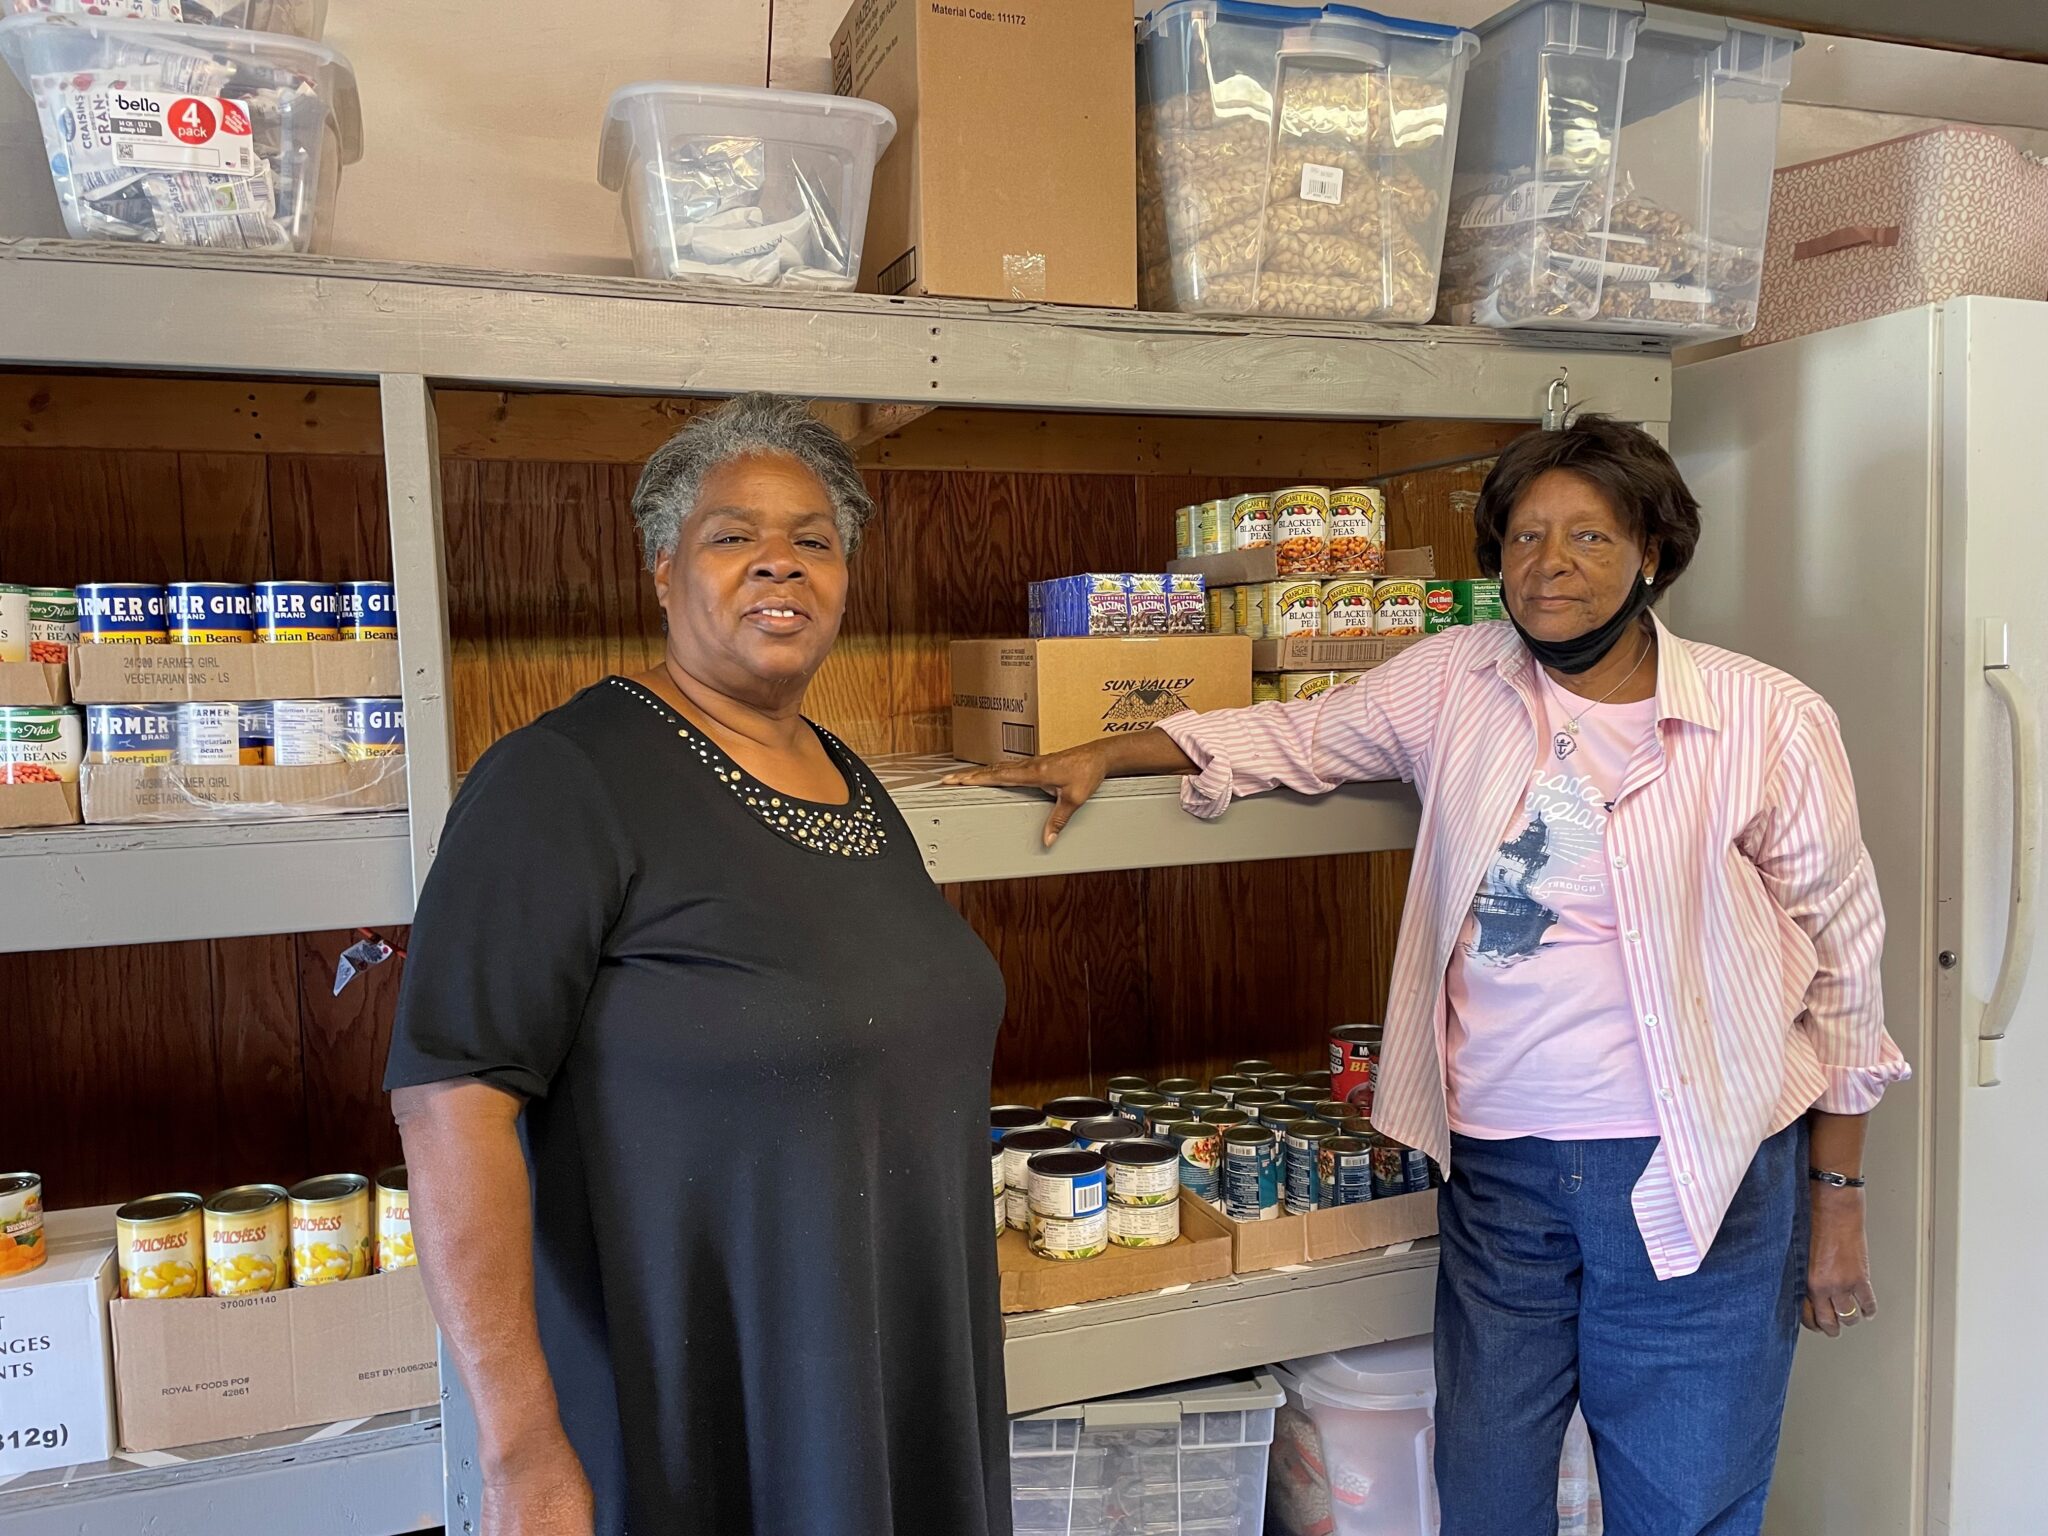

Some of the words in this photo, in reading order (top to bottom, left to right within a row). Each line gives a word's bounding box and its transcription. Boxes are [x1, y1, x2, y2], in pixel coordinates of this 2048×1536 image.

[931, 3, 967, 18] Material
[968, 8, 996, 22] Code:
[997, 12, 1027, 26] 111172
[115, 94, 160, 113] bella
[181, 102, 201, 128] 4
[74, 94, 93, 150] CRAISINS
[178, 125, 208, 139] pack
[1278, 518, 1321, 529] BLACKEYE
[1330, 519, 1366, 529] ACKEYE
[1288, 527, 1312, 536] PEAS
[1333, 528, 1355, 536] PEAS
[110, 615, 145, 623] BRAND
[176, 613, 206, 621] BRAND
[274, 611, 307, 619] BRAND
[1345, 618, 1366, 627] PEAS
[1391, 617, 1414, 626] PEAS
[206, 633, 243, 644] Beans
[363, 630, 399, 641] Beans
[156, 657, 195, 669] FARMER
[197, 656, 220, 668] GIRL
[124, 673, 186, 685] VEGETARIAN
[217, 672, 230, 683] LS
[1101, 680, 1136, 691] SUN
[1139, 678, 1195, 690] VALLEY
[978, 696, 1003, 711] SEEDLESS
[1002, 699, 1024, 713] RAISINS
[89, 716, 169, 735] FARMER
[141, 734, 170, 742] BRAND
[23, 743, 43, 751] Red
[23, 751, 68, 762] BEANS
[208, 776, 230, 788] GIRL
[1547, 881, 1597, 893] THROUGH
[293, 1215, 342, 1232] DUCHESS
[212, 1225, 267, 1244] DUCHESS
[132, 1231, 188, 1253] DUCHESS
[220, 1295, 277, 1311] 3700/01140
[358, 1369, 381, 1382] BEST
[161, 1385, 193, 1397] ROYAL
[195, 1379, 229, 1392] FOODS
[230, 1376, 250, 1387] PO#
